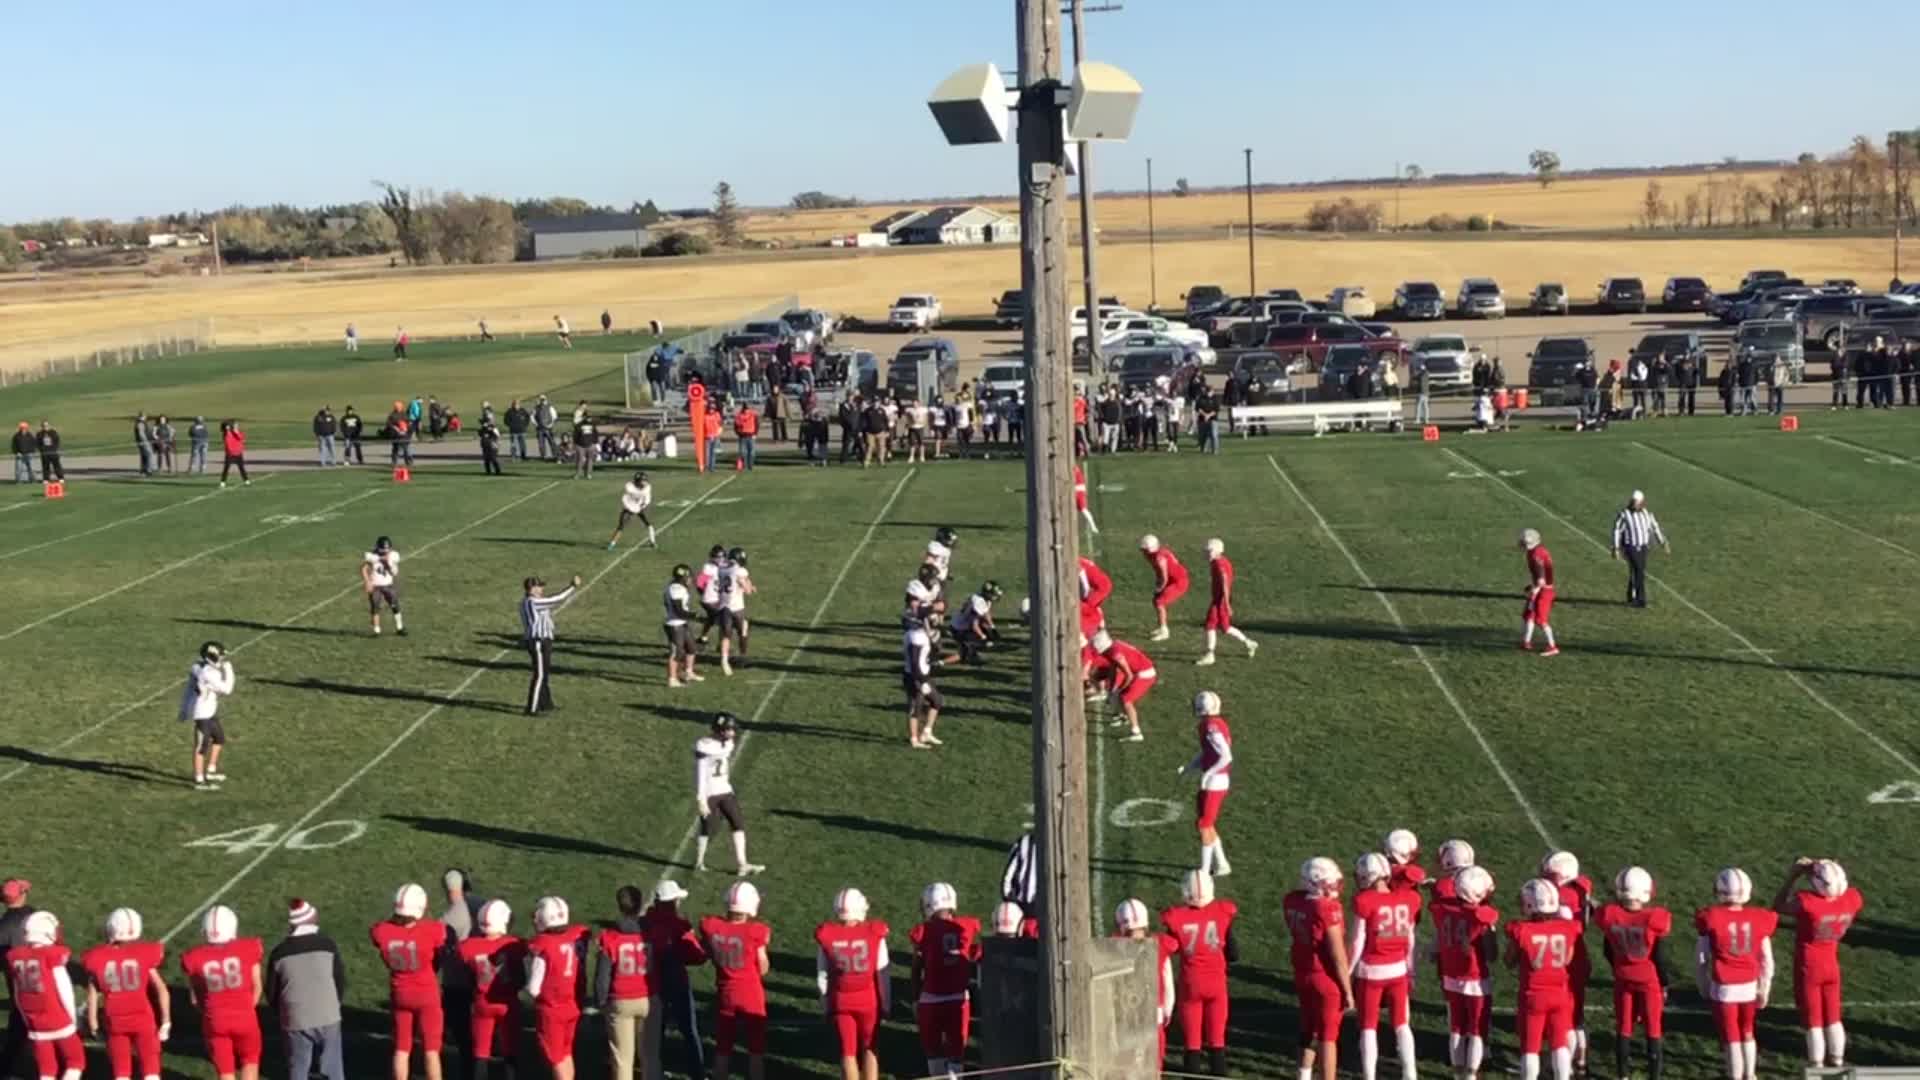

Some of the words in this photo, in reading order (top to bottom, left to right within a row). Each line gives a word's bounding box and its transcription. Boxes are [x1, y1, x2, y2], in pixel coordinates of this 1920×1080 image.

[182, 820, 368, 854] 40
[1376, 904, 1410, 938] 28
[1180, 920, 1219, 957] 74
[1530, 933, 1565, 969] 79
[1727, 922, 1756, 956] 11
[386, 939, 420, 973] 51
[831, 939, 869, 973] 52
[102, 959, 140, 992] 40
[201, 956, 242, 993] 68
